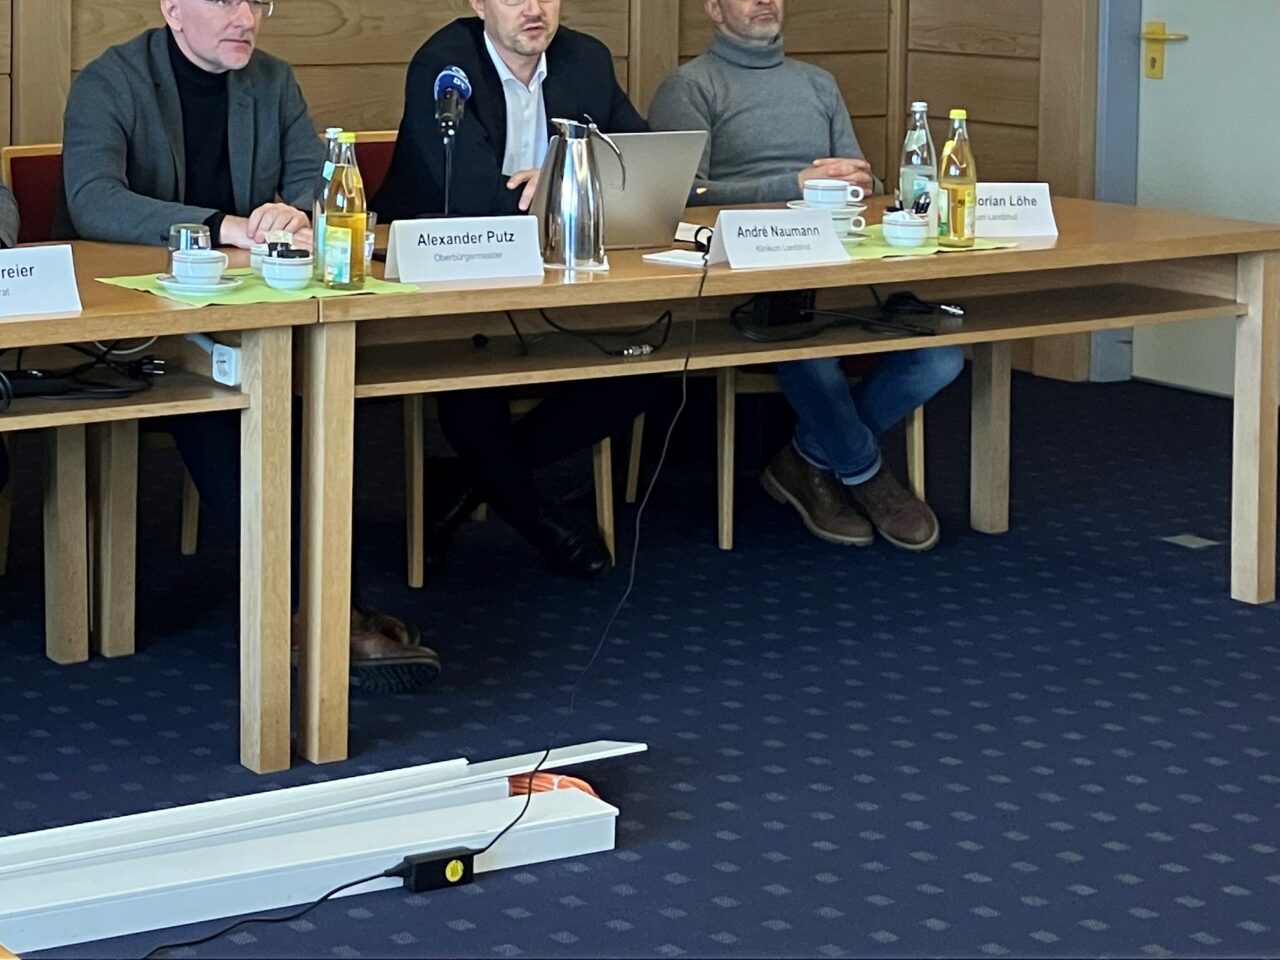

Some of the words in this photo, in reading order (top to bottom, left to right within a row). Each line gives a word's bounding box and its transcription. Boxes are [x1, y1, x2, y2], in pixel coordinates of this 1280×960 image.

[1009, 195, 1038, 207] Löhe
[737, 225, 768, 238] André
[771, 225, 820, 237] Naumann
[417, 232, 483, 247] Alexander
[486, 230, 515, 244] Putz
